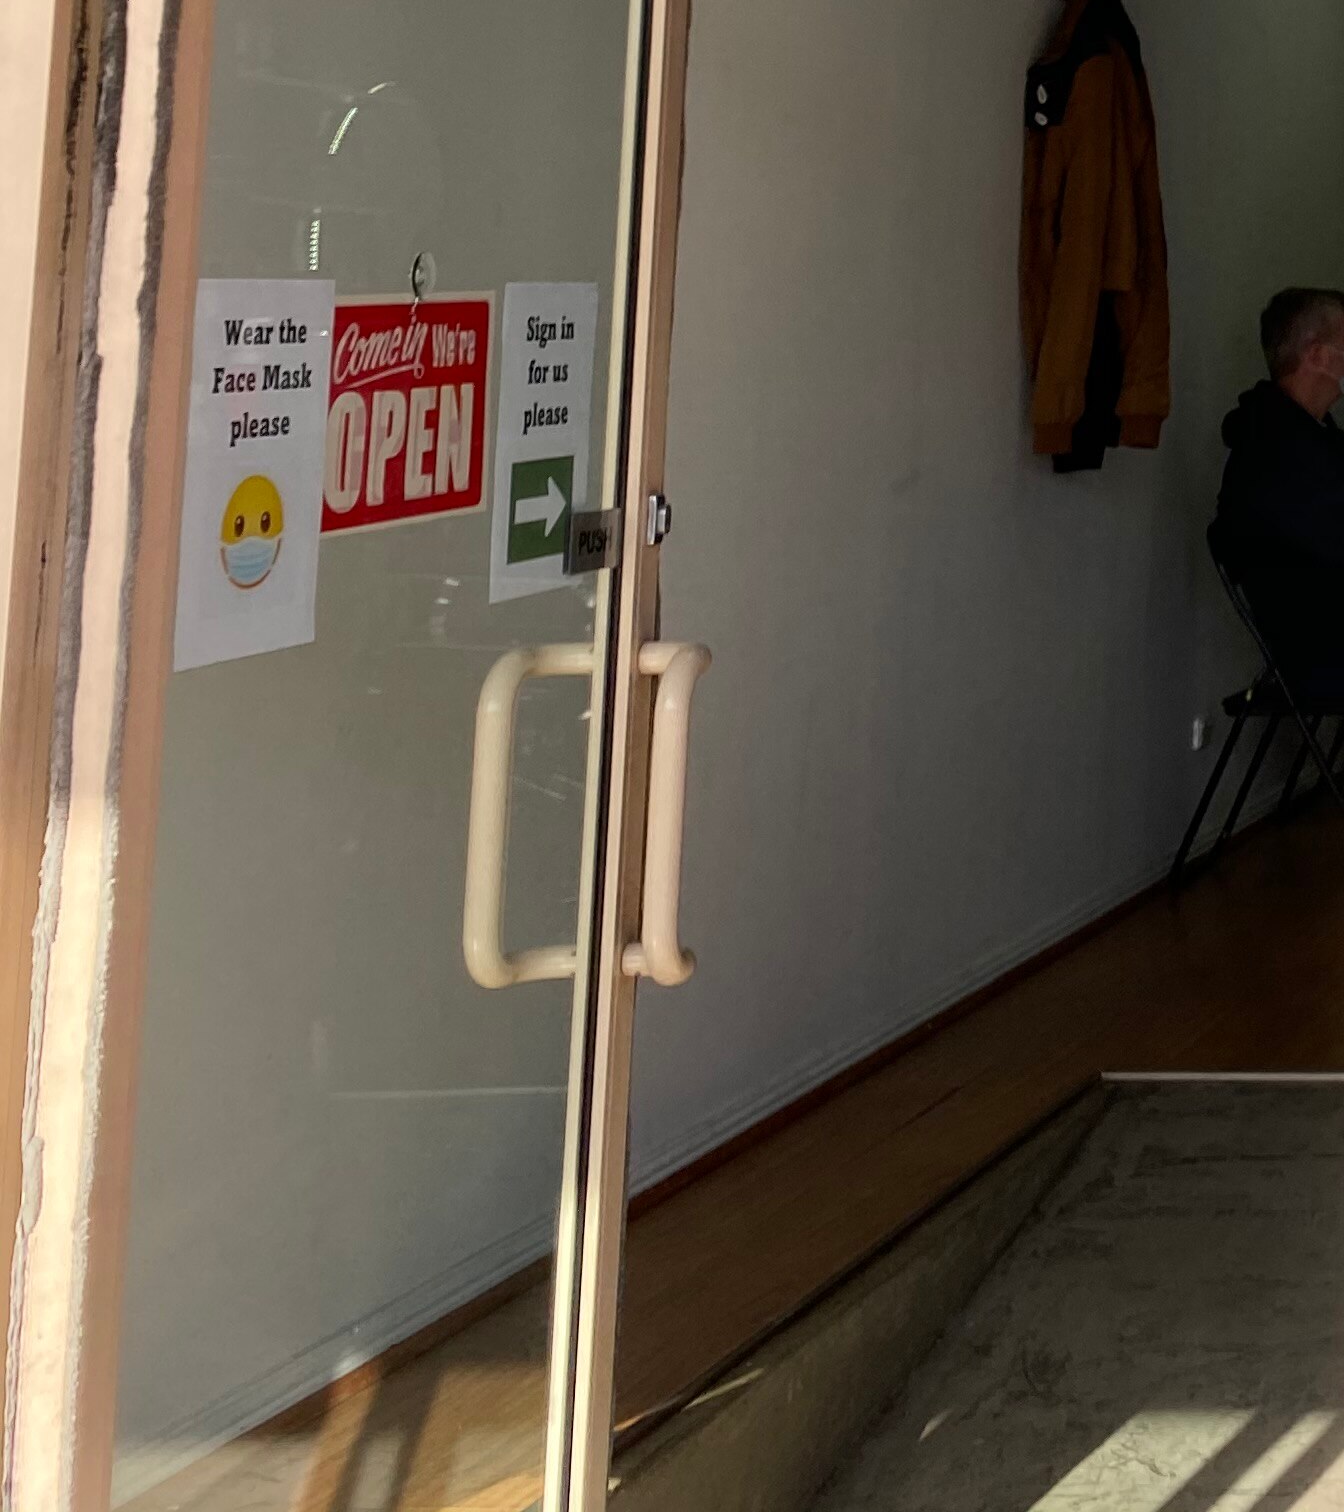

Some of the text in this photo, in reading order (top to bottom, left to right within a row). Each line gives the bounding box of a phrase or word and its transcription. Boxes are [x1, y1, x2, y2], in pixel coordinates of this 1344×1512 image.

[224, 318, 308, 346] Wear the
[526, 315, 575, 348] Sign in
[333, 315, 477, 384] Come in We're
[212, 362, 312, 394] Face Mask
[527, 359, 568, 385] for us
[229, 412, 291, 447] please
[522, 403, 569, 435] please
[324, 383, 475, 514] OPEN
